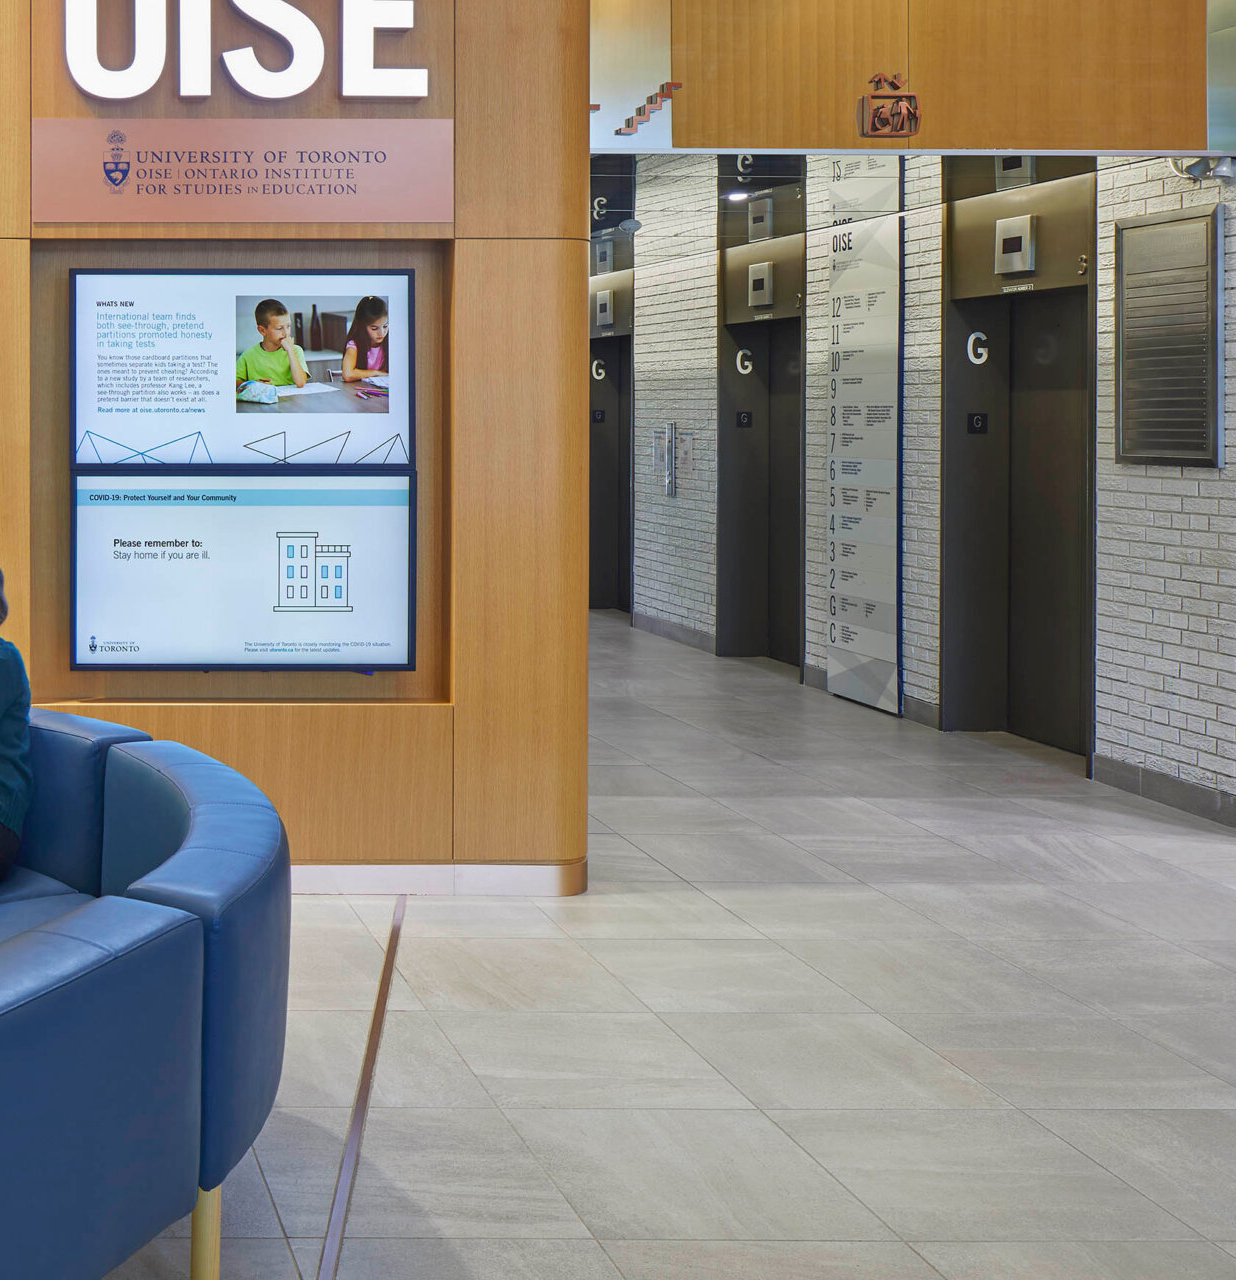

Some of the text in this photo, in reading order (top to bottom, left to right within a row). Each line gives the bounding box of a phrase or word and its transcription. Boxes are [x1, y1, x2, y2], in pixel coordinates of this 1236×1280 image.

[136, 150, 387, 164] UNIVERSITY OF TORONTO
[136, 168, 354, 180] OISE ONTARIO INSTITUTE
[136, 184, 357, 195] FOR STUDIES IN EDUCATION
[832, 231, 853, 253] OISE
[1076, 254, 1088, 276] 3
[97, 312, 196, 320] International team finds
[831, 296, 842, 318] 12
[97, 331, 213, 340] partitions promoted honesty
[117, 322, 169, 331] see-through,
[173, 322, 204, 331] pretend
[831, 324, 840, 345] 11
[97, 340, 156, 349] in taking tests
[966, 331, 989, 365] G
[591, 359, 606, 381] G
[735, 349, 753, 375] G
[831, 351, 840, 372] 10
[831, 378, 836, 399] 9
[830, 405, 836, 426] 8
[973, 415, 983, 428] G
[830, 433, 836, 453] 7
[830, 460, 836, 480] 6
[202, 494, 236, 502] Community
[830, 486, 836, 507] 5
[830, 514, 836, 534] 4
[114, 539, 203, 547] Please remember to:
[830, 541, 836, 562] 3
[113, 551, 132, 561] Stay
[134, 551, 158, 559] home
[161, 551, 165, 559] if
[168, 553, 183, 561] you
[201, 551, 210, 559] ill.
[830, 568, 836, 589] 2
[830, 595, 836, 616] G
[830, 622, 836, 643] C
